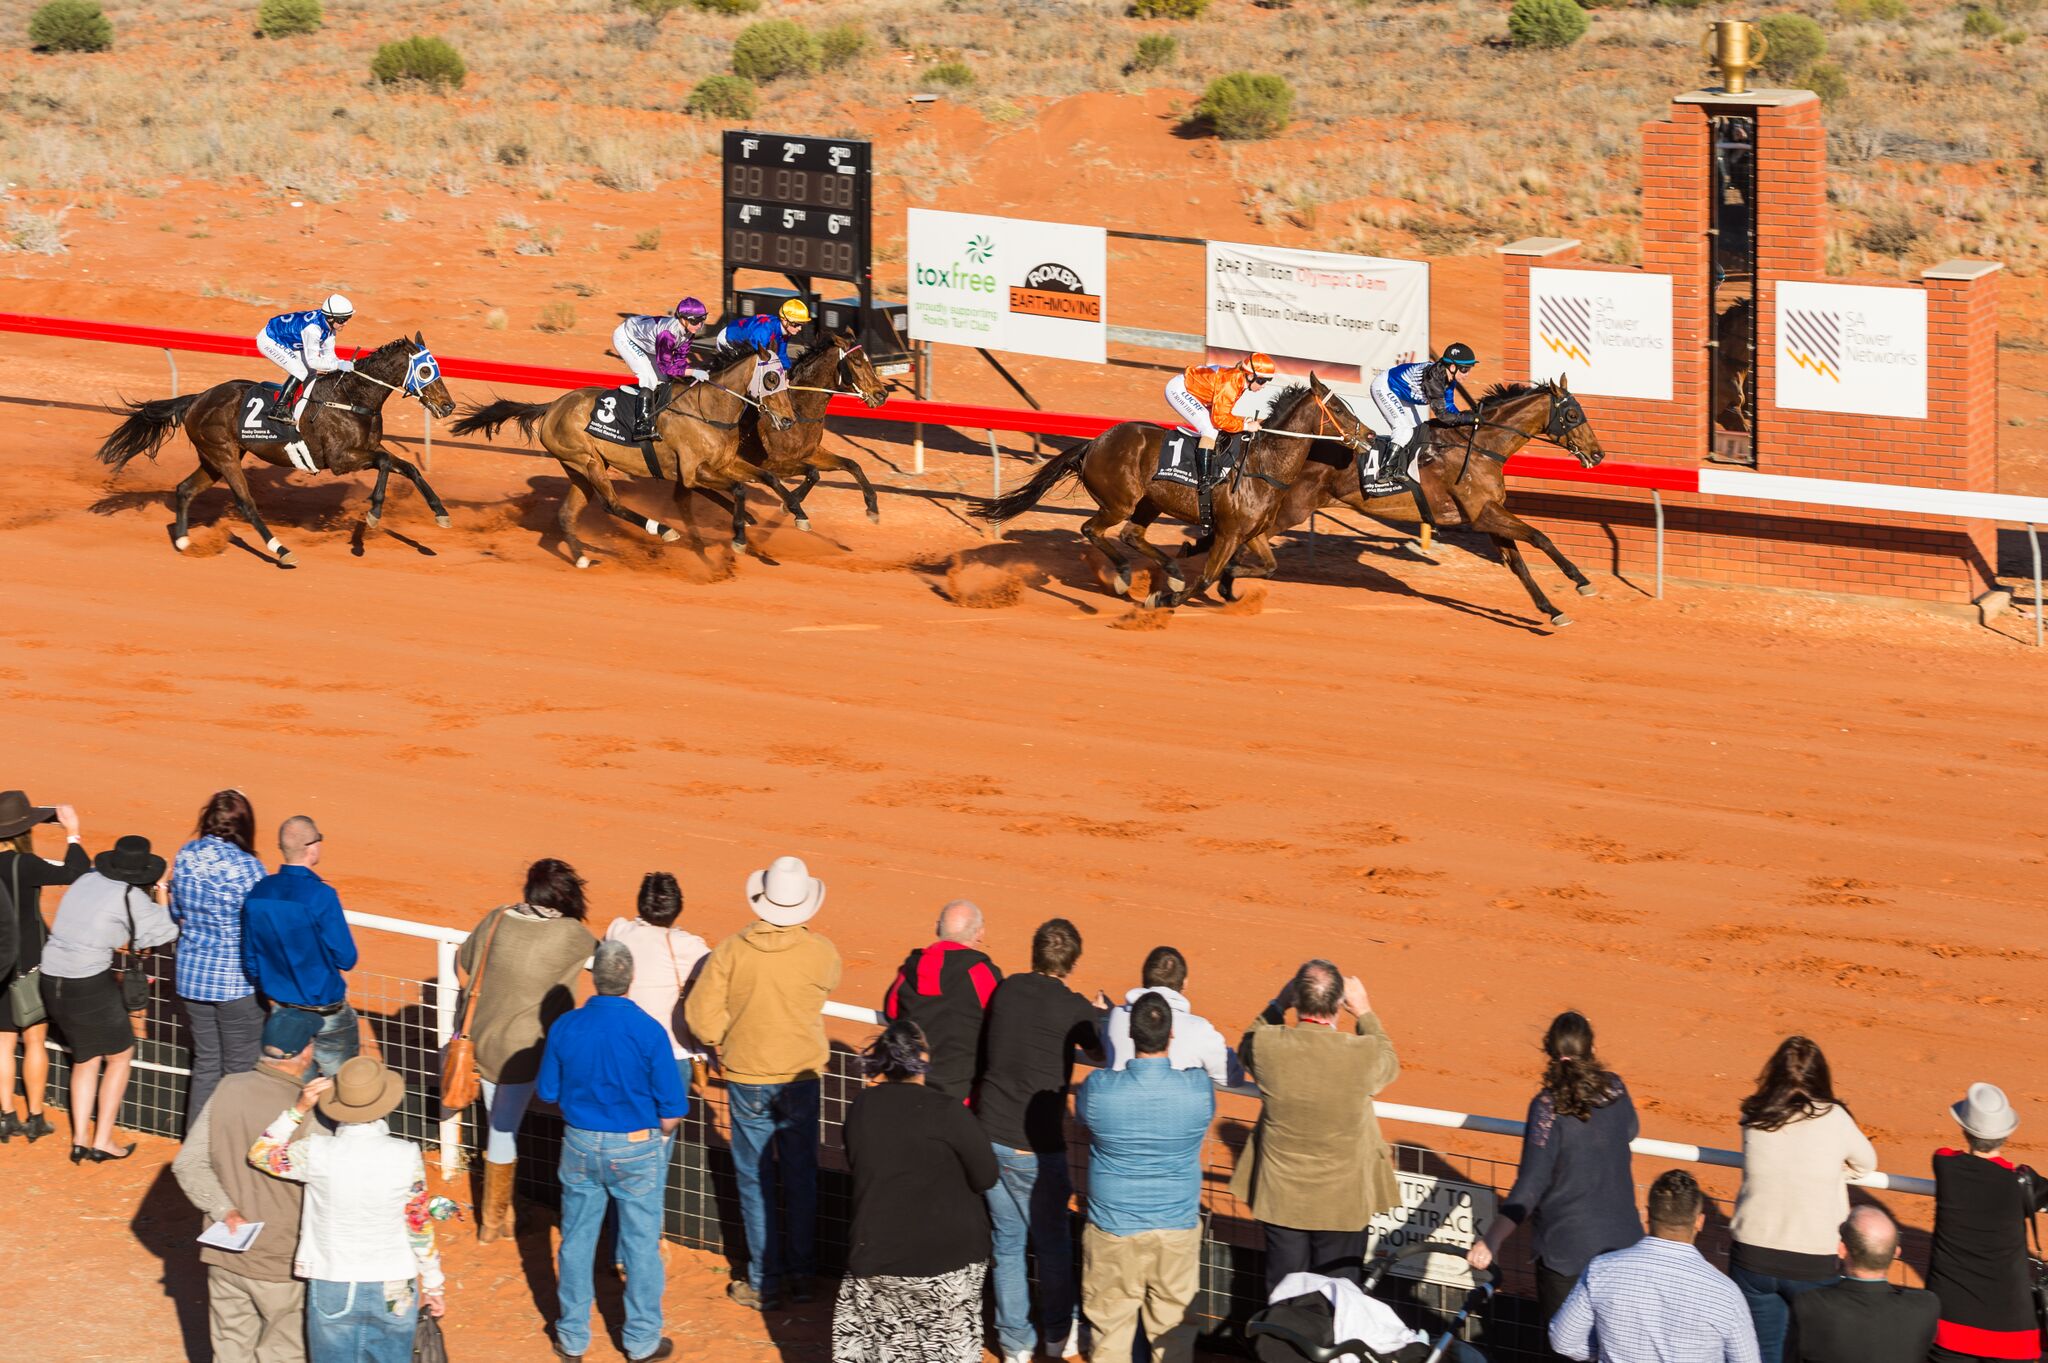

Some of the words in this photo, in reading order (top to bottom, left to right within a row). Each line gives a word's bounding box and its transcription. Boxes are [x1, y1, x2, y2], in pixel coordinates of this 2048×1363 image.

[916, 262, 996, 293] toxfree
[1028, 265, 1082, 292] ROXBY
[1216, 258, 1241, 273] BHP
[1296, 266, 1352, 288] Olympic
[1356, 274, 1388, 291] Dam
[1010, 293, 1099, 317] EARTHMOVING
[1596, 296, 1615, 311] SA
[1216, 299, 1236, 314] BHP
[1242, 302, 1281, 321] Billiton
[1283, 308, 1331, 327] Outback
[1333, 314, 1374, 333] Copper
[1377, 319, 1401, 337] Cup
[1596, 313, 1640, 331] Power
[1845, 311, 1865, 326] SA
[1597, 331, 1664, 350] Networks
[1846, 328, 1892, 346] Power
[1846, 346, 1919, 366] Networks
[244, 397, 265, 429] 2
[596, 396, 617, 424] 3
[1168, 438, 1185, 467] 1
[1363, 450, 1381, 480] 4
[1398, 1181, 1441, 1204] TRY
[1445, 1188, 1473, 1208] TO
